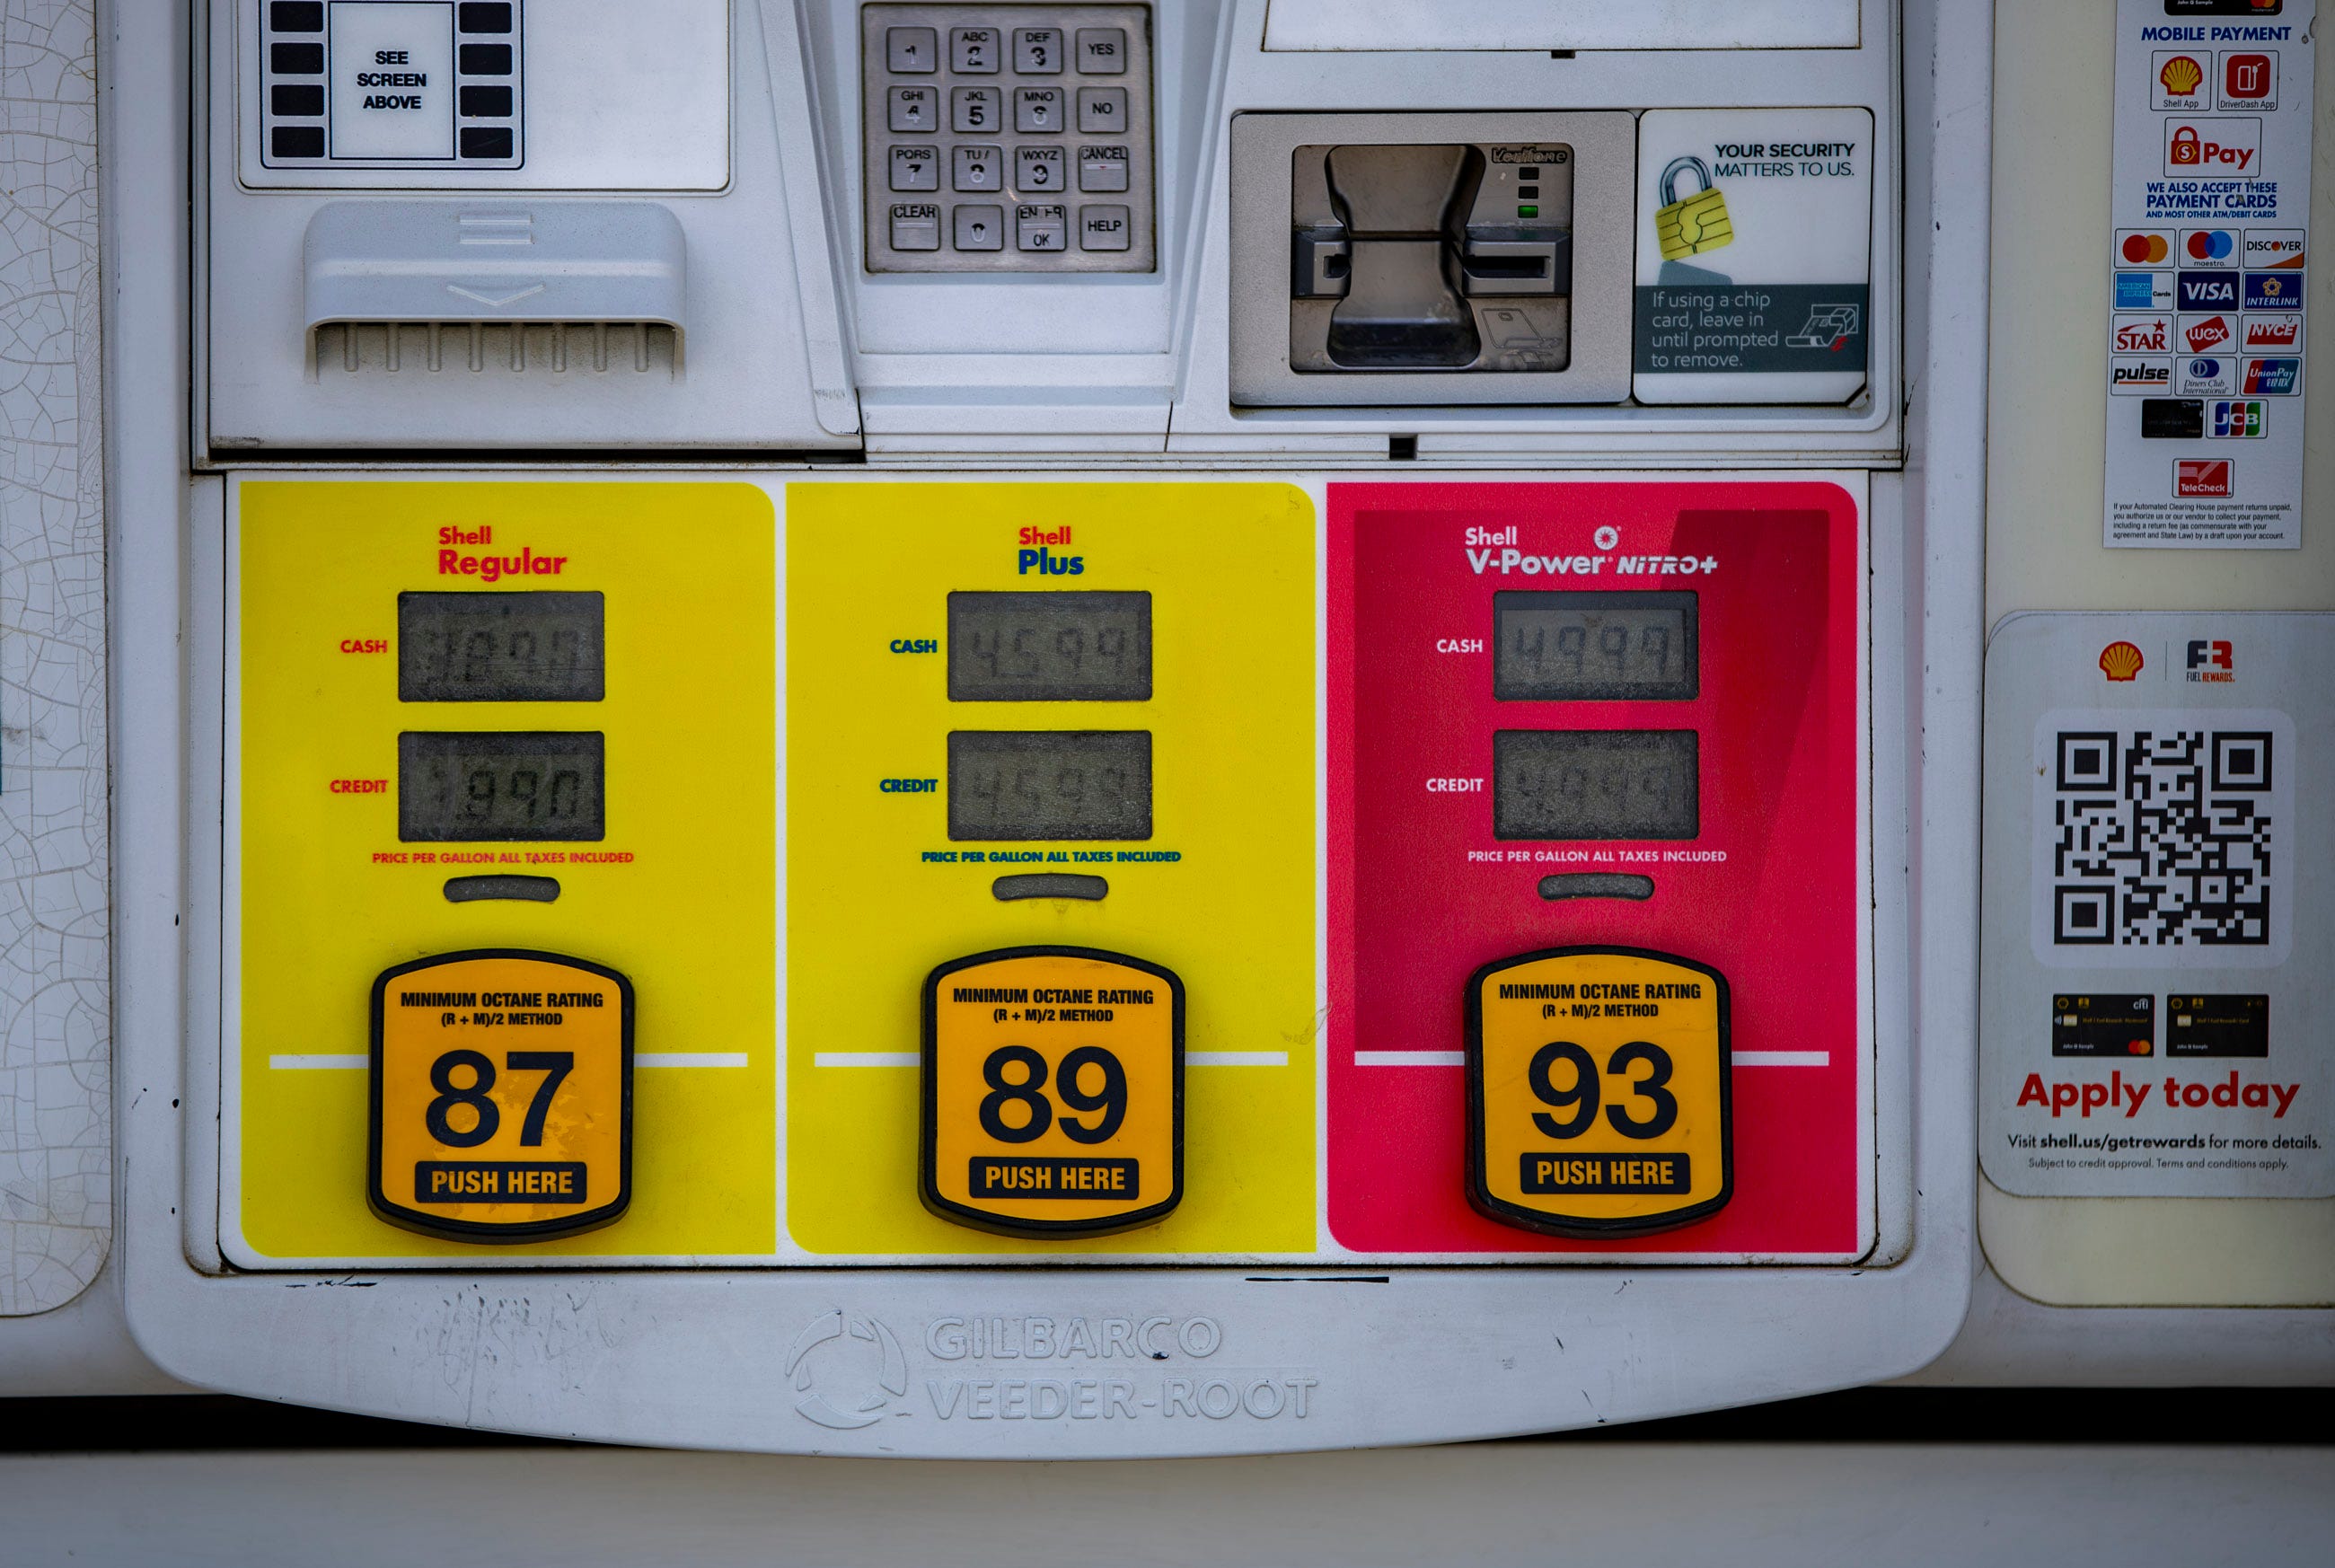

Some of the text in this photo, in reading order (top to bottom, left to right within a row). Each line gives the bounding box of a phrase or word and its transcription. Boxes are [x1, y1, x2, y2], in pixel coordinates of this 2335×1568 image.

[962, 32, 988, 41] ABC
[1026, 32, 1051, 42] DEF
[2142, 27, 2291, 40] MOBILE PAYMENT
[1088, 44, 1114, 55] YES
[375, 51, 409, 65] SEE
[357, 73, 427, 87] SCREEN
[363, 95, 421, 110] ABOVE
[902, 91, 923, 101] GHI
[965, 92, 987, 101] JKL
[1025, 92, 1053, 101] MNO
[1092, 103, 1112, 114] NO
[2184, 101, 2198, 109] App
[2220, 101, 2275, 109] DriverDash App
[969, 106, 983, 126] 5
[896, 150, 930, 160] PQRS
[1022, 150, 1058, 160] WXYZ
[1081, 147, 1126, 160] CANCEL
[1715, 144, 1855, 157] YOUR SECURITY
[2204, 143, 2254, 170] Pay
[1715, 163, 1855, 177] MATTERS TO US.
[2147, 182, 2277, 193] WE ALSO ACCEPT THESE
[2147, 195, 2277, 208] PAYMENT CARDS
[894, 207, 935, 218] CLEAR
[1088, 220, 1122, 231] HELP
[1034, 233, 1050, 246] OK
[2247, 241, 2301, 251] DISCOVER
[2182, 283, 2234, 300] VISA
[1652, 291, 1770, 311] If using a chip
[2247, 297, 2298, 305] INTERLINK
[1652, 313, 1764, 330] card, leave in
[2189, 327, 2225, 340] wex
[2251, 323, 2295, 336] NYCE
[1652, 330, 1778, 350] until prompted
[2117, 333, 2166, 350] STAR
[1652, 353, 1743, 367] to remove.
[2113, 363, 2170, 383] pulse
[2250, 368, 2294, 382] UnionPay
[2215, 413, 2259, 426] JCB
[2181, 484, 2225, 492] TeleCheck
[438, 525, 492, 545] Shell
[1019, 525, 1071, 545] Shell
[1465, 526, 1517, 545] Shell
[438, 547, 567, 582] Regular
[1019, 547, 1084, 576] Plus
[1466, 549, 1608, 575] V-Power
[339, 640, 388, 654] CASH
[890, 639, 938, 654] CASH
[1436, 639, 1483, 653] CASH
[2187, 672, 2200, 682] FUEL
[330, 780, 388, 794] CREDIT
[880, 779, 938, 793] CREDIT
[1426, 779, 1484, 792] CREDIT
[373, 852, 634, 864] PRICE PER GALLON ALL TAXES INCLUDED
[921, 851, 1181, 863] PRICE PER GALLON ALL TAXES INCLUDED
[1468, 850, 1727, 862] PRICE PER GALLON ALL TAXES INCLUDED
[954, 989, 1153, 1004] MINIMUM OCTANE RATING
[1500, 984, 1701, 1000] MINIMUM OCTANE RATING
[401, 992, 603, 1008] MINIMUM OCTANE RATING
[993, 1009, 1114, 1024] (R + M)/2 METHOD
[1542, 1004, 1658, 1019] (R + M)/2 METHOD
[441, 1013, 562, 1027] (R + M)/2 METHOD
[979, 1045, 1128, 1144] 89
[1528, 1041, 1678, 1140] 93
[2017, 1070, 2300, 1119] Apply today
[426, 1049, 574, 1148] 87
[2007, 1133, 2322, 1152] Visit shell.us/getrewards for more details.
[2029, 1158, 2289, 1170] Subject to credit approval. Terms and conditions apply.
[985, 1167, 1124, 1190] PUSH HERE
[1537, 1161, 1674, 1185] PUSH HERE
[432, 1171, 573, 1194] PUSH HERE
[925, 1316, 1223, 1361] GILBARCO
[926, 1378, 1318, 1421] VEEDER-ROOT
